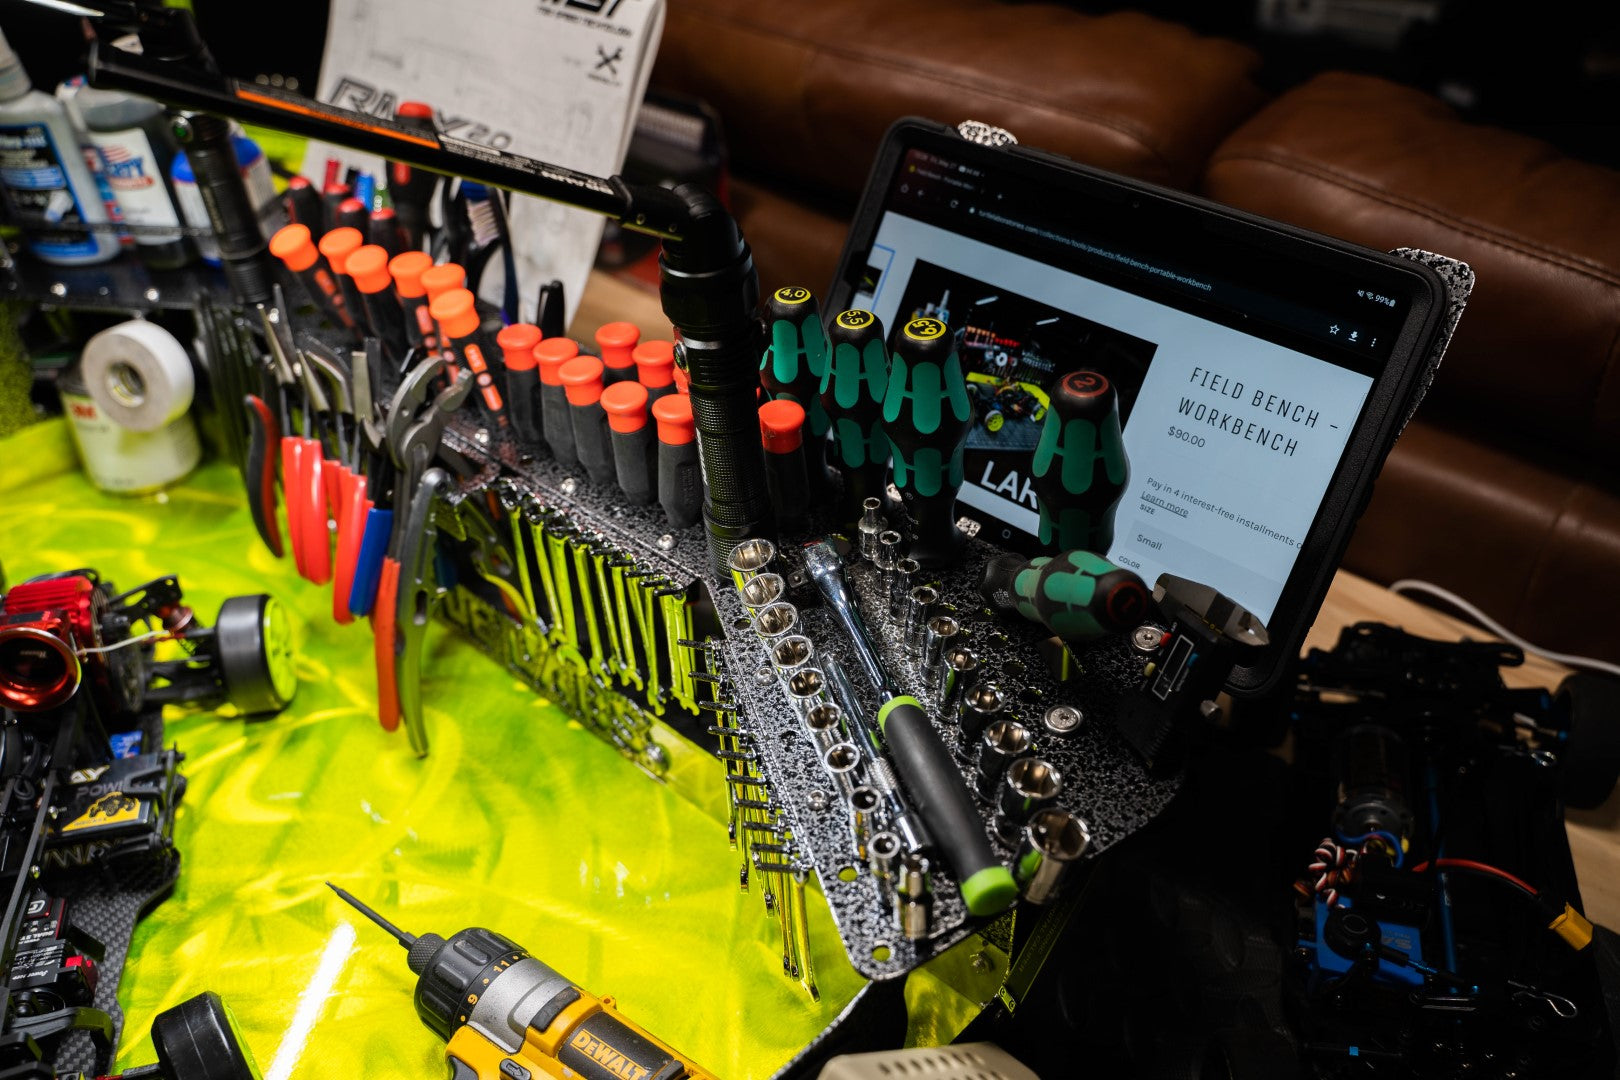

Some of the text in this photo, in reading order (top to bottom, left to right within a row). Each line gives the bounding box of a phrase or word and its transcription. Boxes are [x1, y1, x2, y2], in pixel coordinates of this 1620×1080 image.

[1375, 294, 1390, 305] 99%
[1190, 367, 1244, 399] FIELD
[1251, 390, 1320, 428] BENCH
[1168, 426, 1206, 448] $90.00
[1178, 397, 1298, 456] WORKBENCH
[1139, 503, 1156, 515] SIZE
[1140, 491, 1189, 518] Learn more
[1146, 477, 1162, 492] Pay
[1163, 484, 1172, 494] in
[1180, 492, 1235, 521] interest-free
[1236, 514, 1294, 546] installments
[1136, 534, 1162, 551] Small
[1118, 555, 1140, 569] COLOR
[571, 1030, 649, 1080] DEWALT
